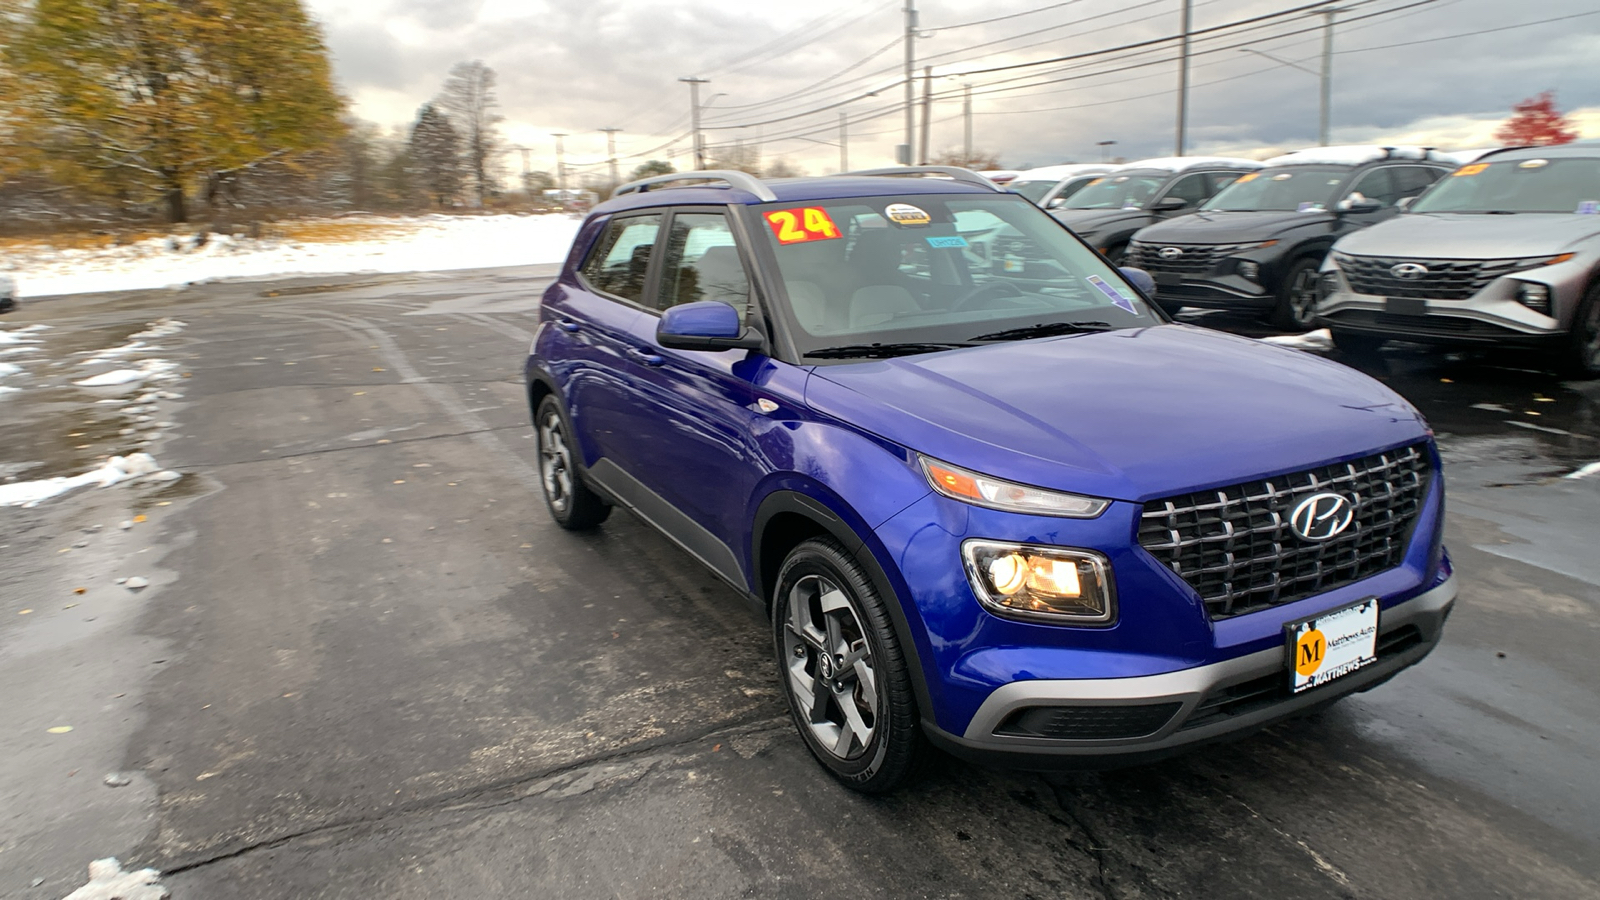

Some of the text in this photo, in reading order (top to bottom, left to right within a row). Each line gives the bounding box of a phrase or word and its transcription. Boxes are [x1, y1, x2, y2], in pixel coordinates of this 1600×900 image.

[767, 208, 836, 242] 24
[1327, 631, 1359, 649] Matthews
[1359, 626, 1376, 637] Auto
[1300, 639, 1321, 667] M
[1313, 659, 1360, 686] MATTHEWS
